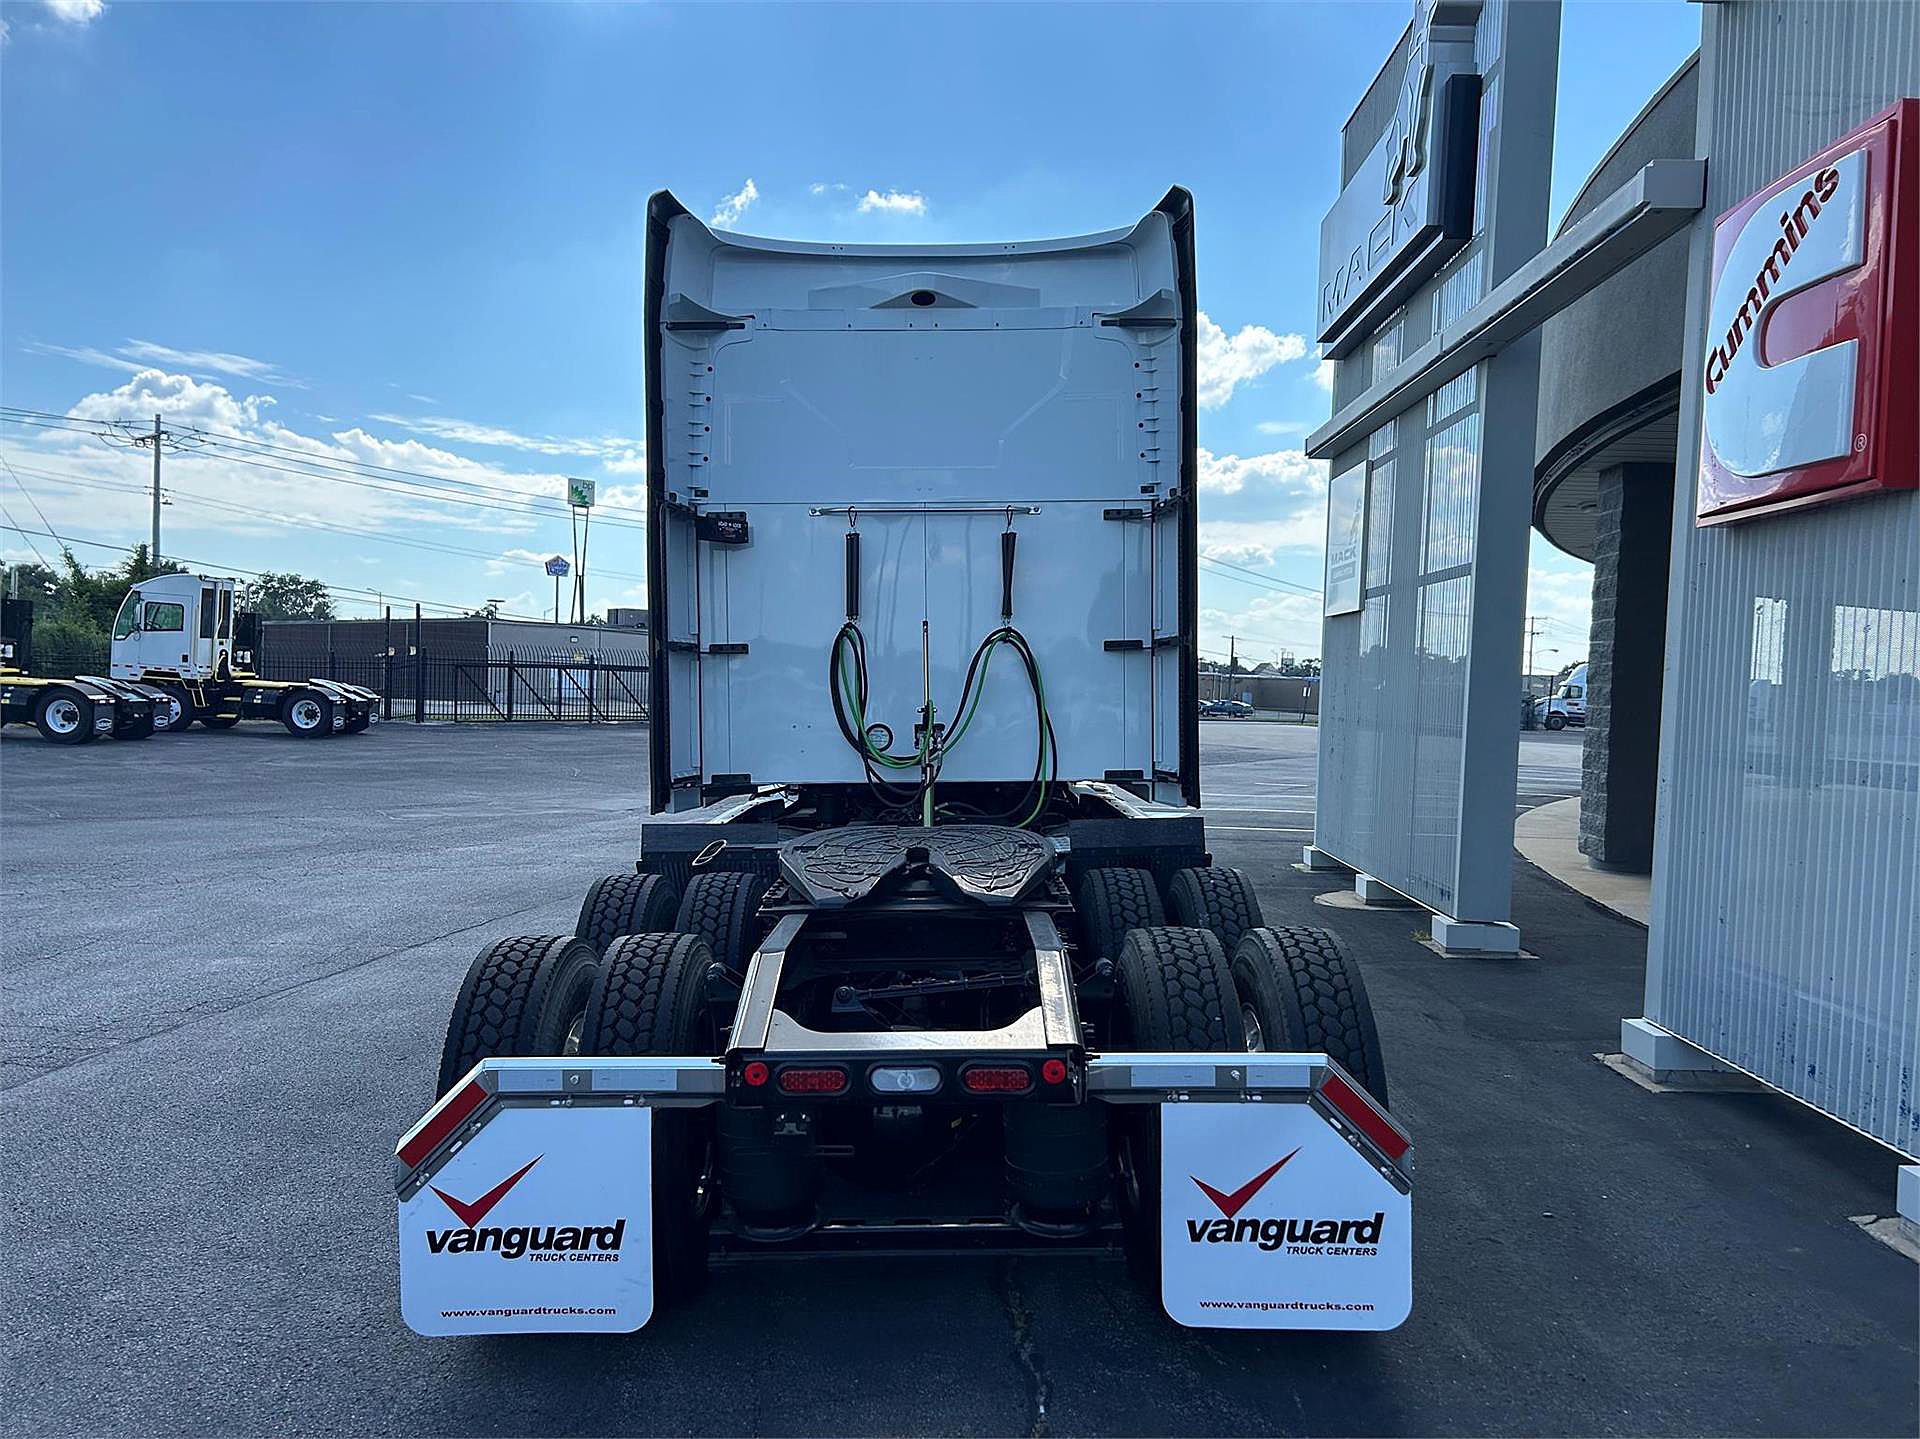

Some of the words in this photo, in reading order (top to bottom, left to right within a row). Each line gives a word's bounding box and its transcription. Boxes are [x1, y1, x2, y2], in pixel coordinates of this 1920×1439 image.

[1322, 177, 1418, 322] MACK
[1705, 166, 1840, 395] Cummins
[426, 1217, 626, 1260] vanguard
[1186, 1212, 1385, 1252] vanguard
[529, 1253, 566, 1262] TRUCK
[569, 1253, 619, 1262] CENTERS
[1286, 1245, 1323, 1256] TRUCK
[1326, 1246, 1378, 1257] CENTERS
[440, 1306, 617, 1318] www.vanguardtrucks.com
[1199, 1300, 1375, 1312] www.vanguardtrucks.com
